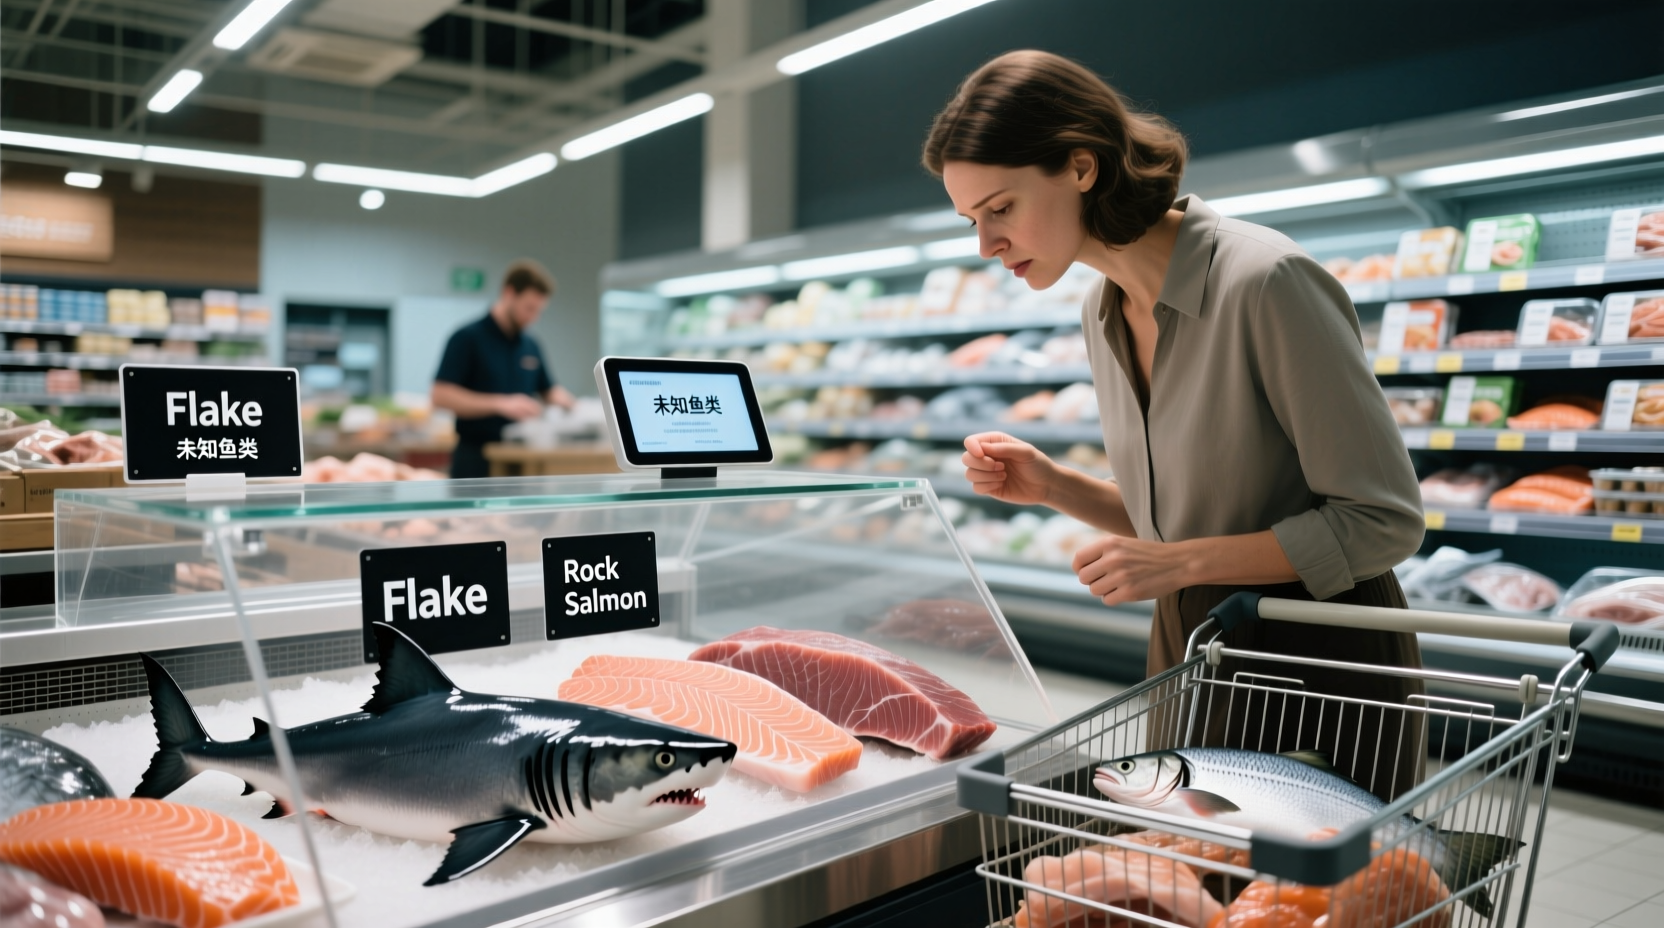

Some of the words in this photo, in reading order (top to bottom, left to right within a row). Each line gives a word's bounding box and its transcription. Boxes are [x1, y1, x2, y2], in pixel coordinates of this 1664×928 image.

[166, 390, 263, 427] Flake
[653, 394, 723, 416] 未知鱼类
[176, 436, 259, 460] 未知鱼类
[563, 555, 619, 584] Rock
[382, 574, 488, 622] Flake
[564, 588, 647, 616] Salmon
